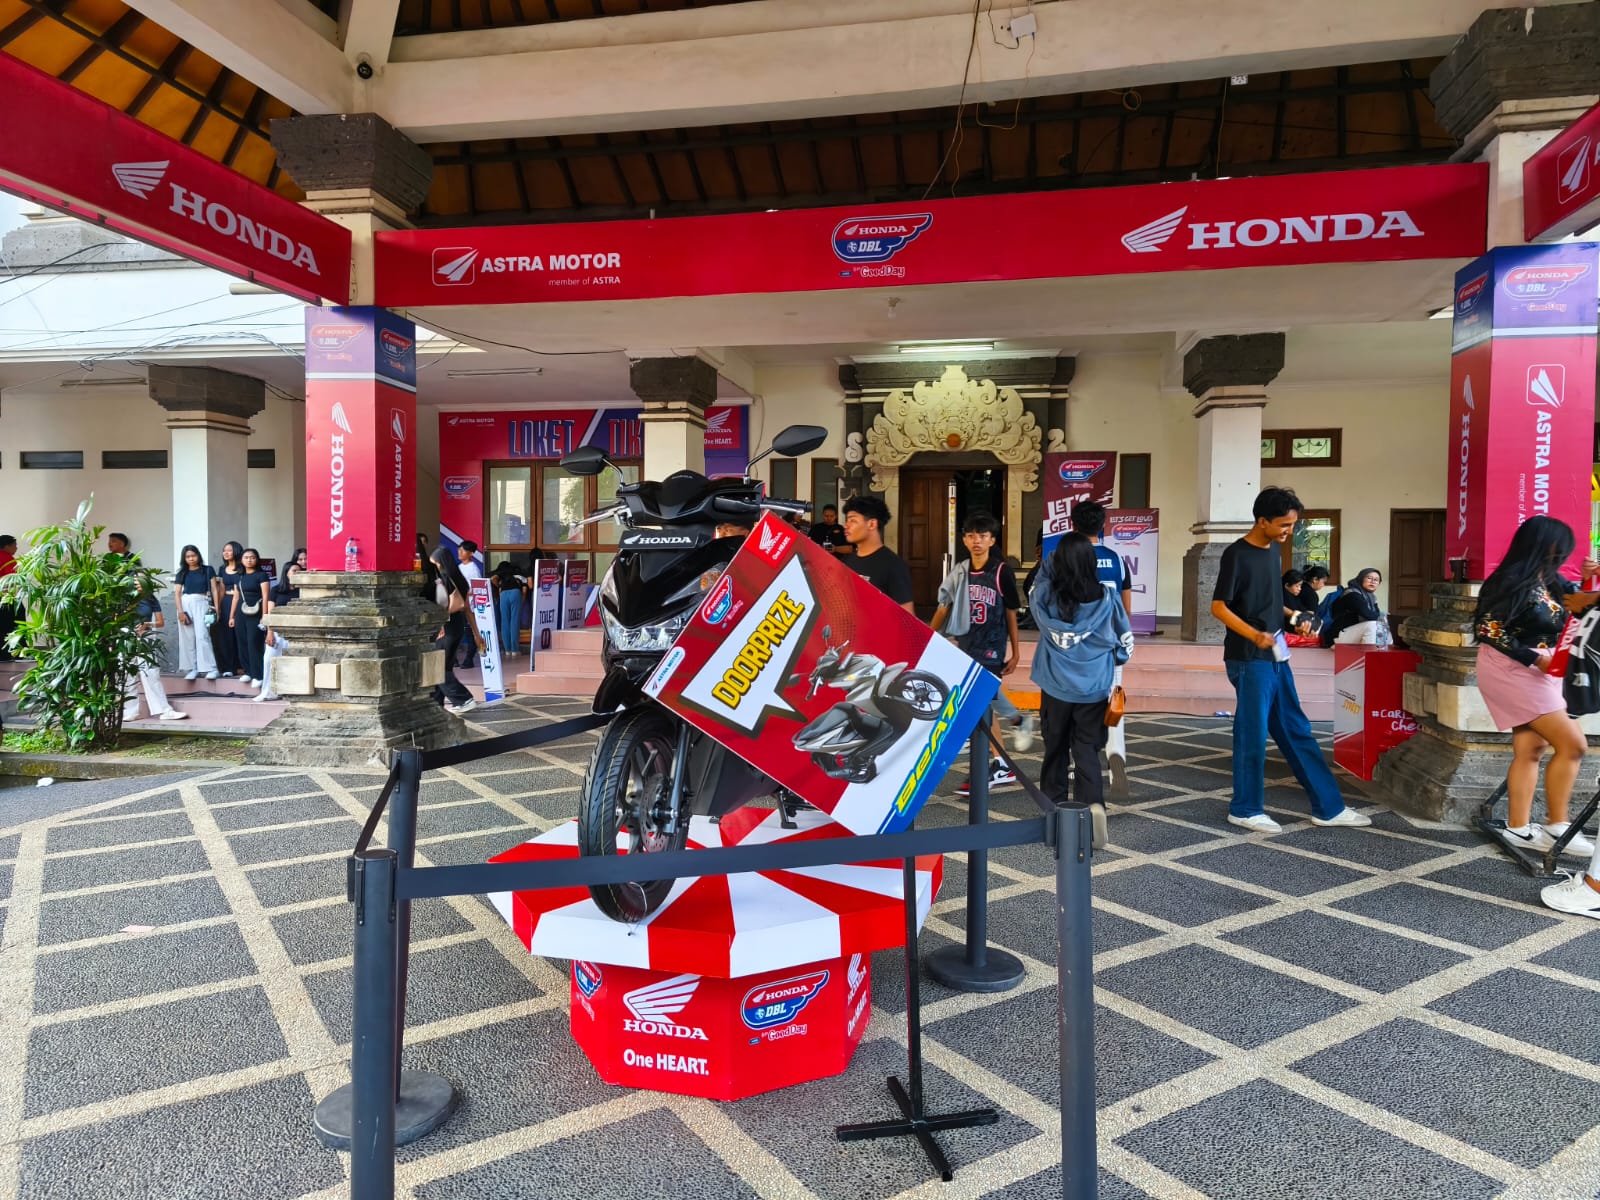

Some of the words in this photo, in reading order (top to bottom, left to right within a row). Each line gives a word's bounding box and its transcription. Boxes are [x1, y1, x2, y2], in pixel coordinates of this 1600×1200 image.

[169, 182, 321, 276] HONDA
[859, 225, 907, 235] HONDA
[1187, 210, 1425, 250] HONDA
[858, 241, 882, 252] DBL
[481, 256, 544, 273] ASTRA
[549, 252, 621, 271] MOTOR
[549, 278, 580, 286] member
[582, 277, 590, 285] of
[592, 276, 621, 285] ASTRA
[509, 420, 575, 457] LOKET
[1535, 410, 1552, 469] ASTRA
[394, 444, 403, 489] ASTRA
[1458, 411, 1470, 540] HONDA
[330, 434, 345, 540] HONDA
[1518, 473, 1527, 502] member
[1533, 473, 1549, 516] MOT
[394, 493, 402, 542] MOTOR
[1518, 503, 1526, 512] of
[639, 536, 692, 545] HONDA
[711, 590, 805, 710] DOORPRIZE
[765, 984, 809, 1001] HONDA
[765, 1002, 787, 1018] DBL
[623, 1019, 709, 1041] HONDA
[623, 1048, 653, 1069] One
[656, 1053, 709, 1076] HEART.
